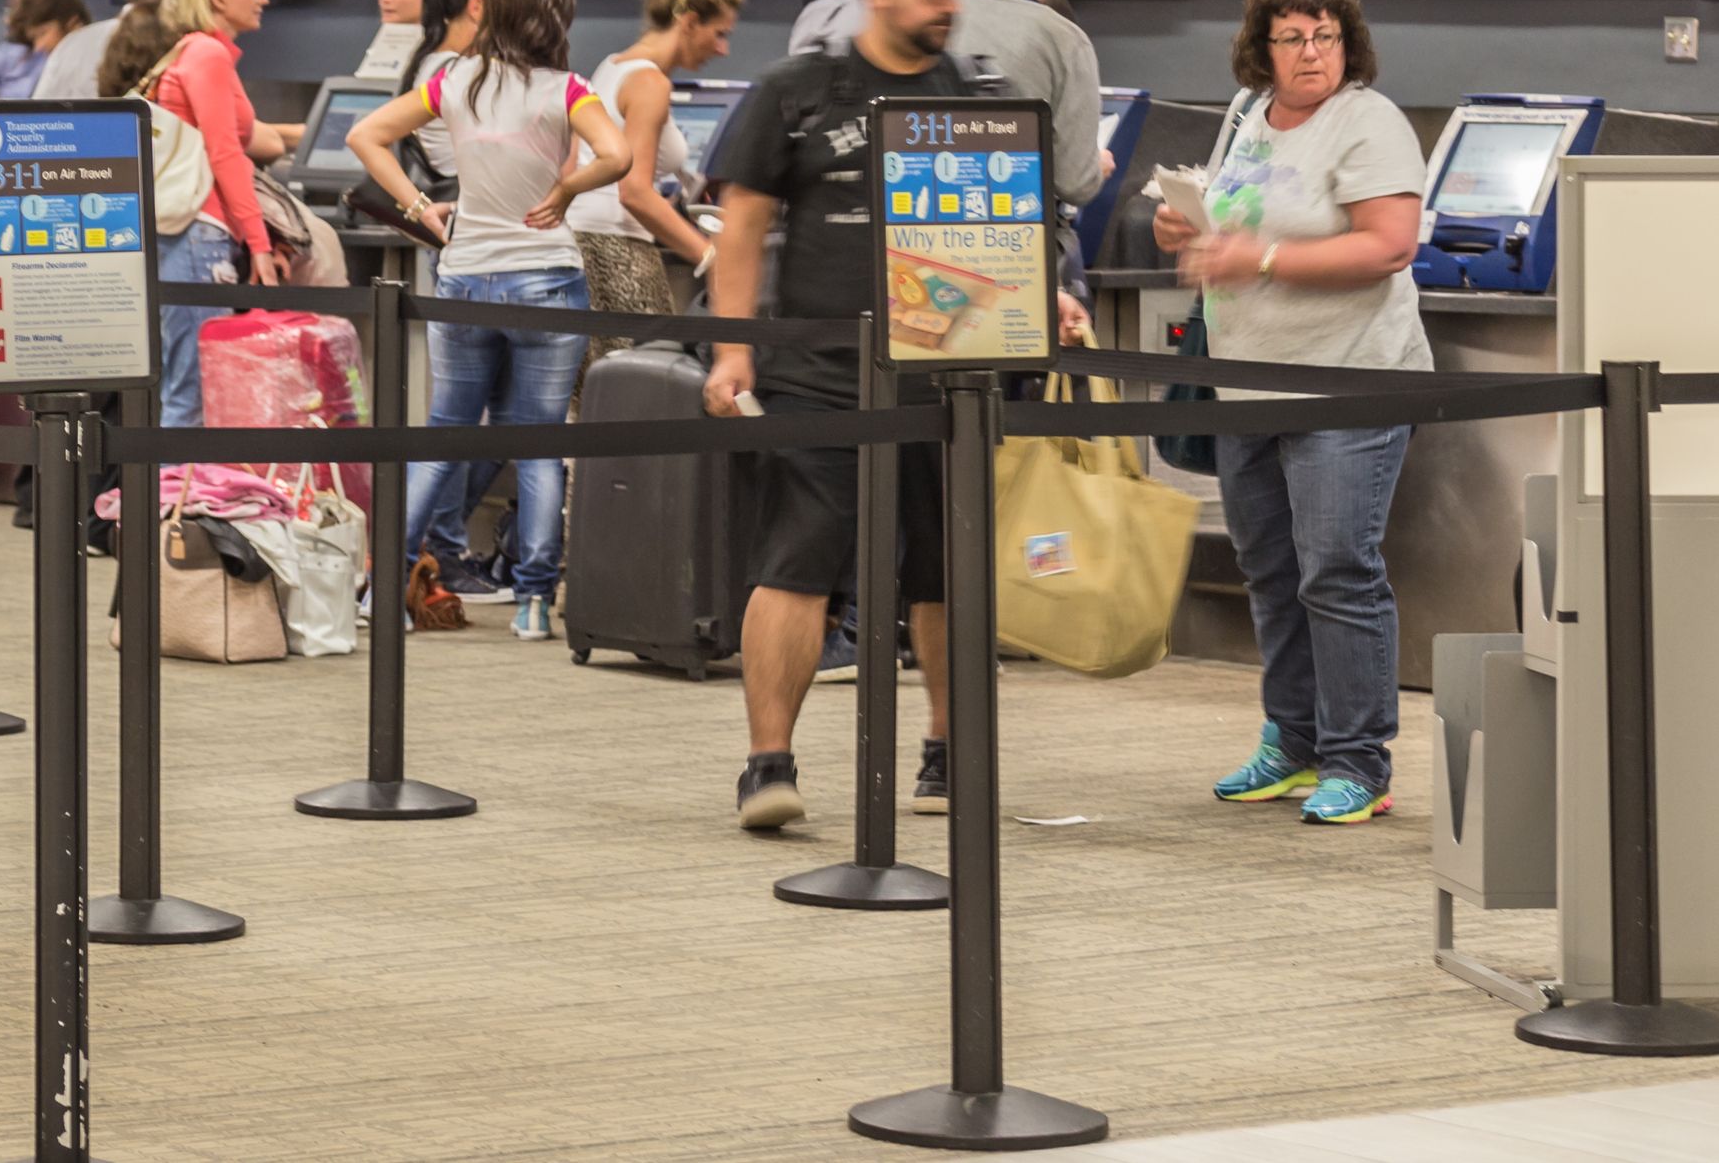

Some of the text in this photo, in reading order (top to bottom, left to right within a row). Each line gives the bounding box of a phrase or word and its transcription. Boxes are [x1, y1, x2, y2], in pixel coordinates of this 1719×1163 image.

[5, 120, 75, 133] Transportation
[905, 111, 1018, 146] 3-1-1 on Air Travel
[6, 132, 45, 144] Security
[6, 143, 77, 154] Administration
[42, 170, 58, 181] on
[59, 168, 77, 181] Air
[78, 167, 113, 180] Travel
[893, 225, 1035, 253] Why the Bag?
[11, 261, 88, 270] Firearms Declaration
[14, 334, 63, 343] Film Warning
